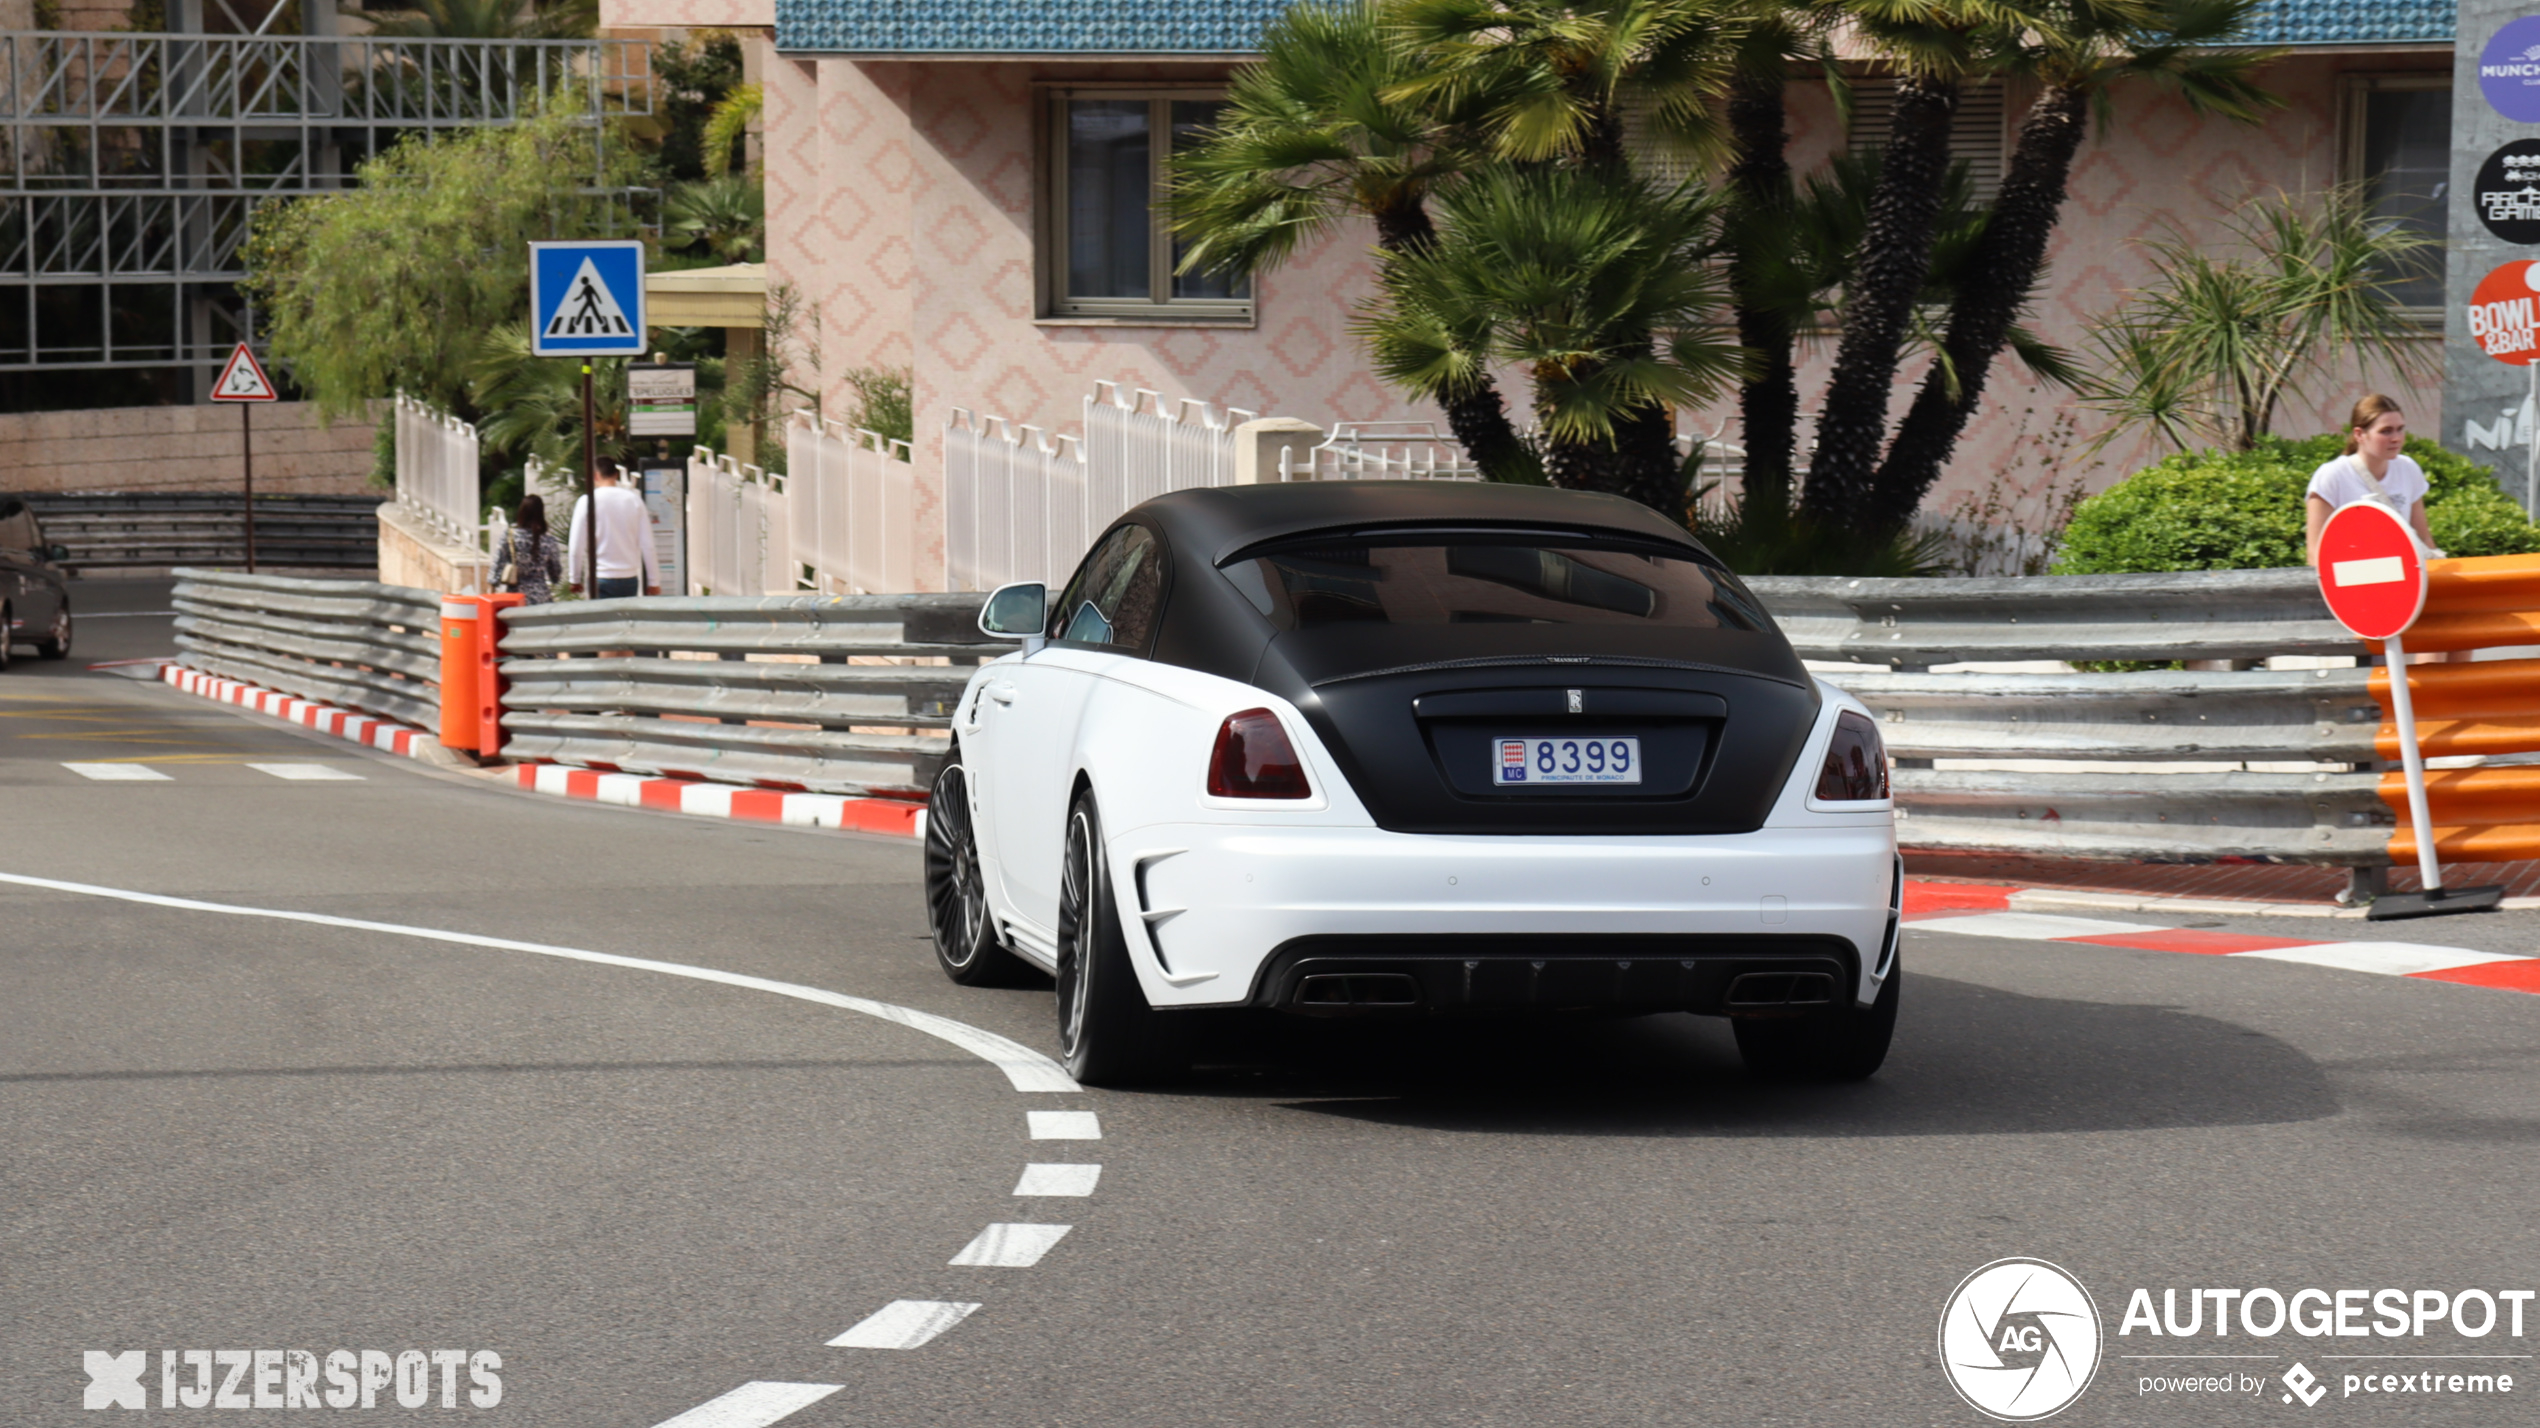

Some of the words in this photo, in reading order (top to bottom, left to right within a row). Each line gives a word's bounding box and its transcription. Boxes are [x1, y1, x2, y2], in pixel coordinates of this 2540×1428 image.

[2484, 328, 2537, 355] &BAR
[633, 387, 692, 396] SPELUGUES
[1537, 741, 1630, 773] 8399
[1507, 768, 1522, 779] MC
